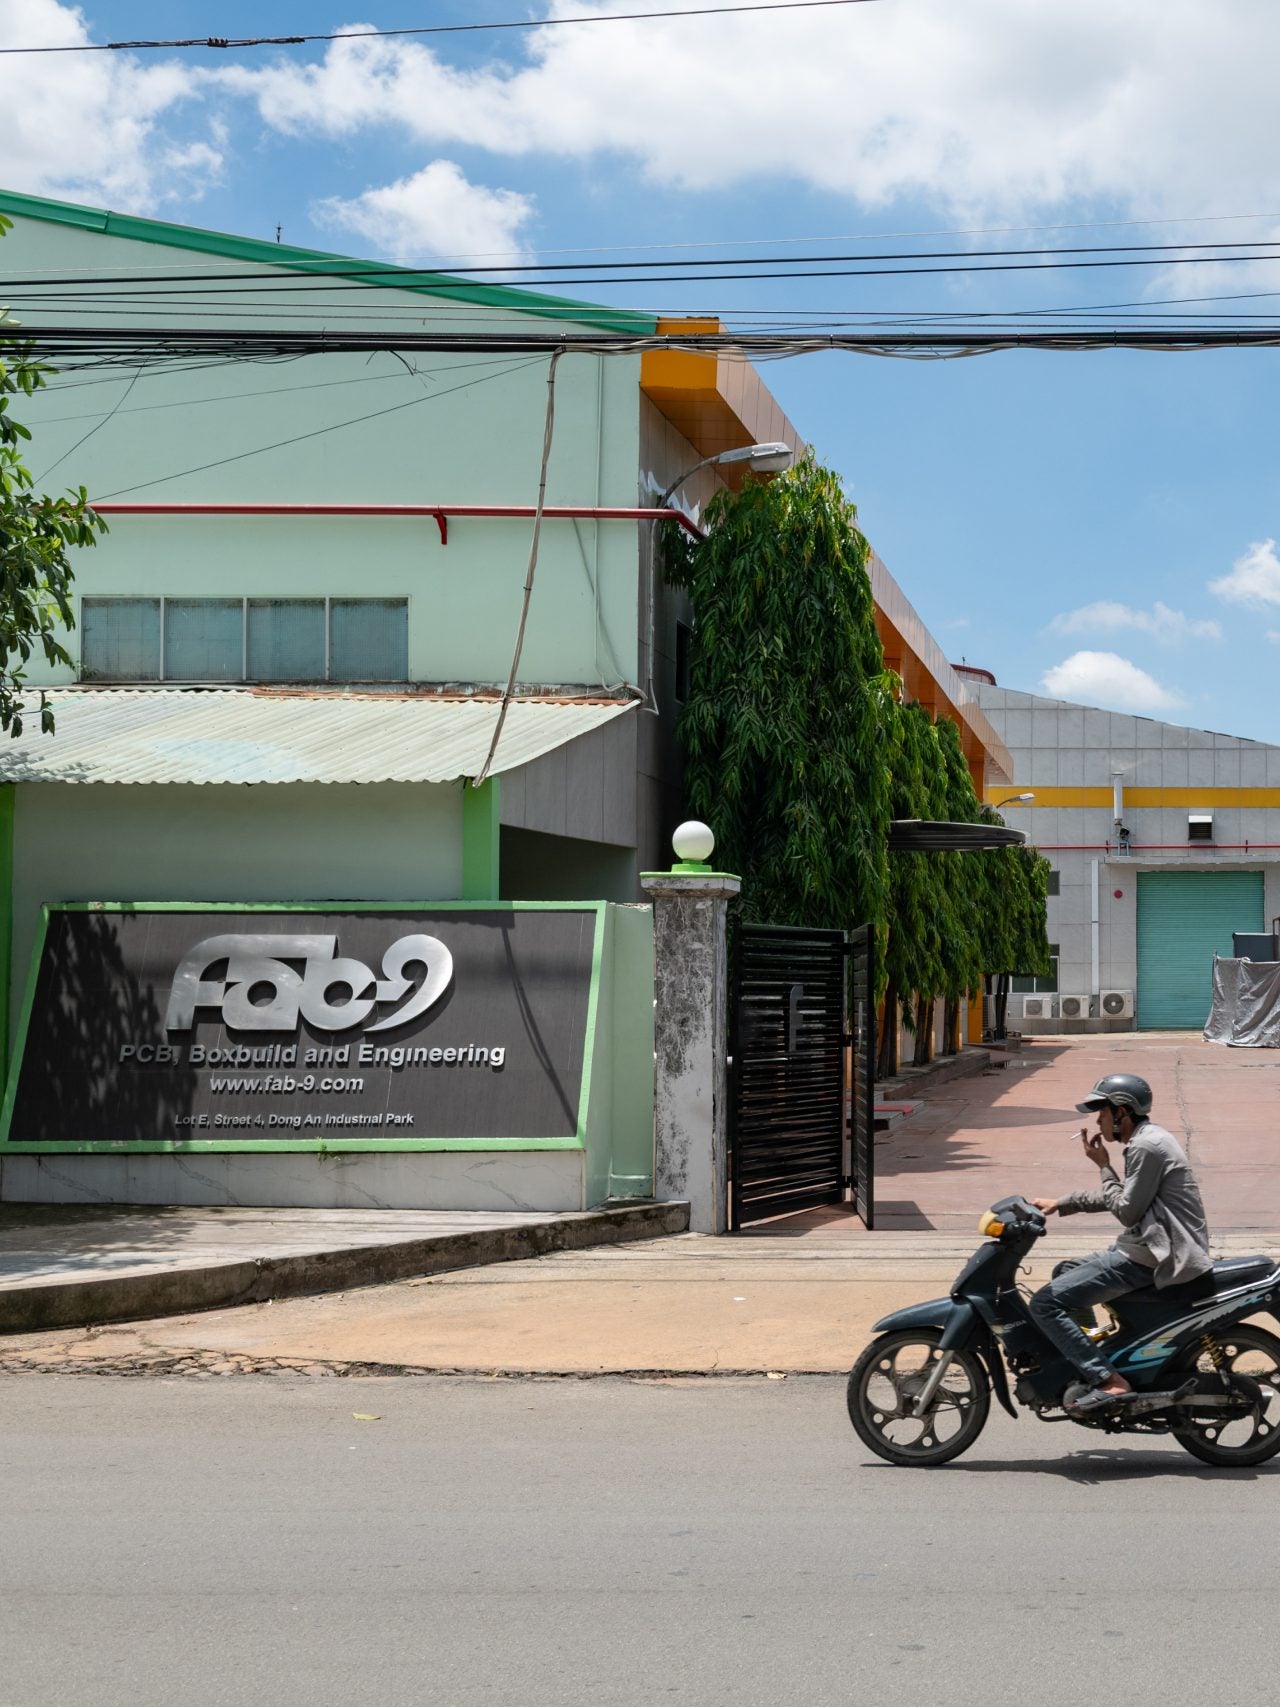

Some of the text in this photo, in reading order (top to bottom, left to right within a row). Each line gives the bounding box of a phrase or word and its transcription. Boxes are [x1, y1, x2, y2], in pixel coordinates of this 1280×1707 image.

[119, 1043, 505, 1067] PCB, Boxbuild and Engineering
[210, 1074, 364, 1091] www.fab-9.com
[174, 1113, 414, 1127] Lot E, Street 4, Dong An Industrial Park
